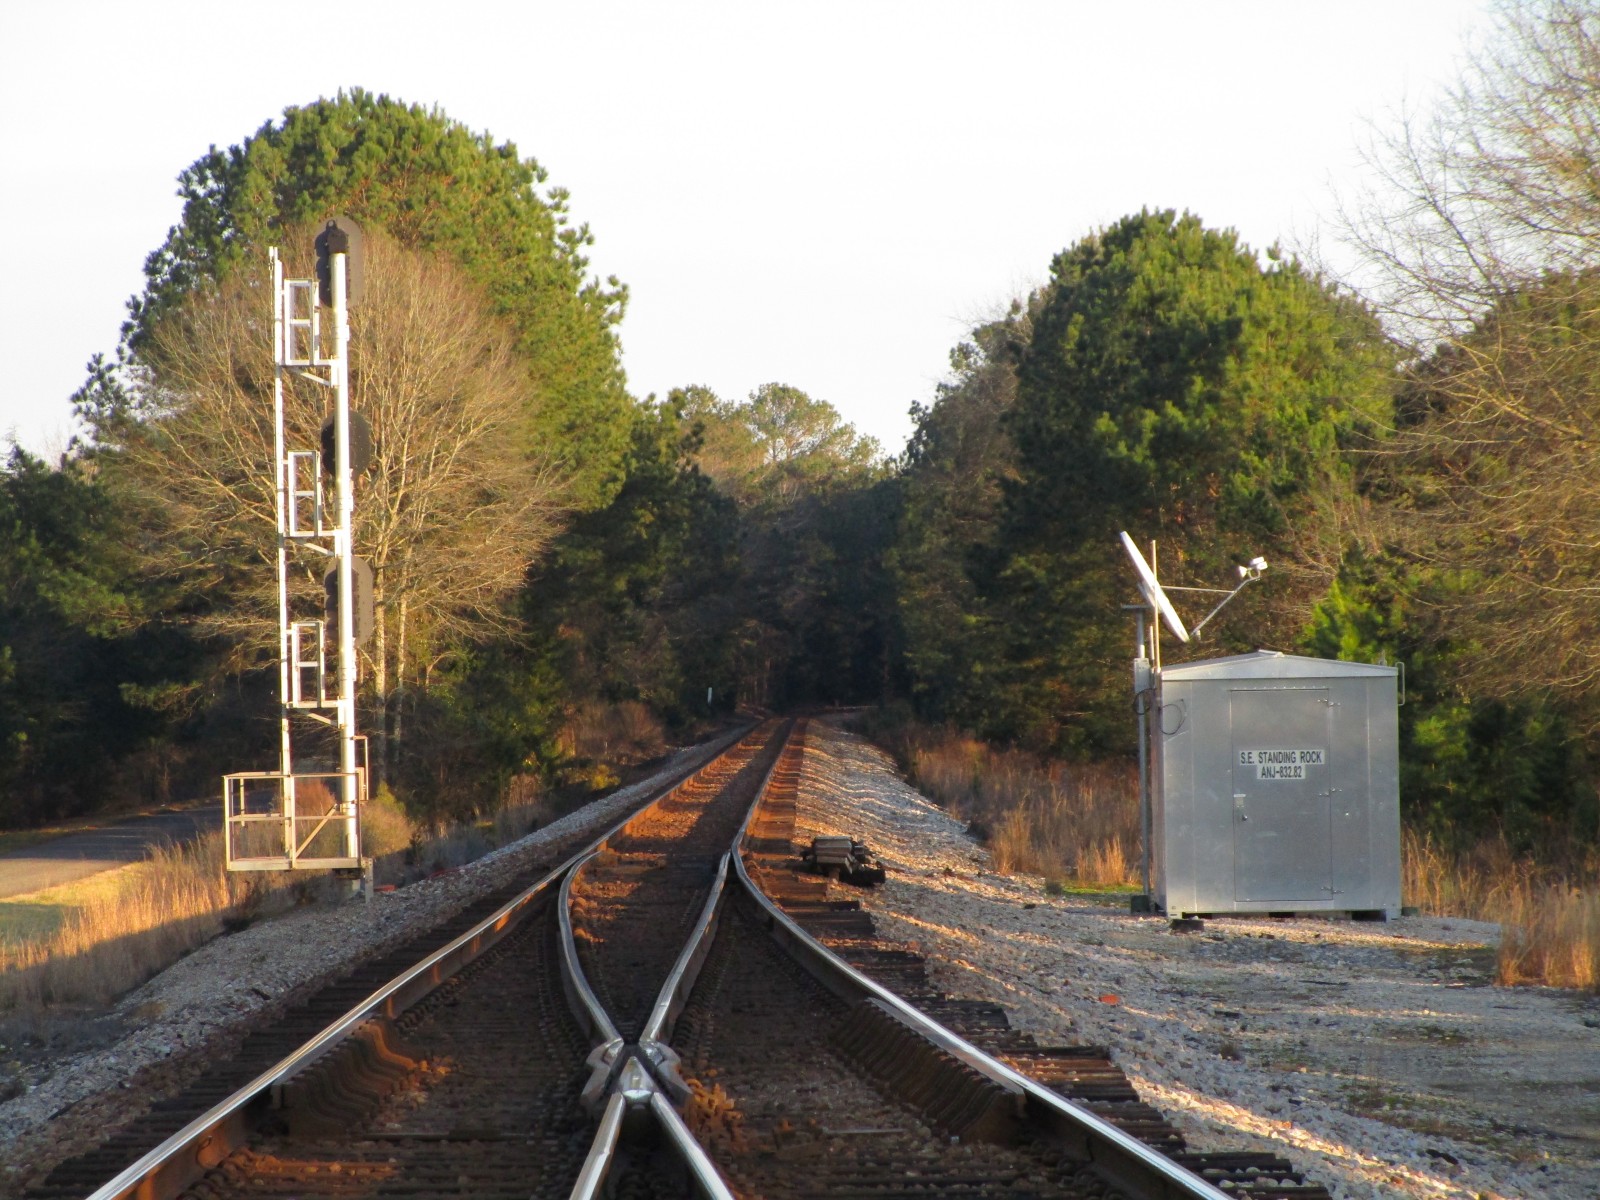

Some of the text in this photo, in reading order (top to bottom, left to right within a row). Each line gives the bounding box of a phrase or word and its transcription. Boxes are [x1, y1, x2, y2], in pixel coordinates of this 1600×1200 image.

[1240, 751, 1322, 764] S.E. STANDING ROCK
[1261, 766, 1302, 778] ANJ-832.82
